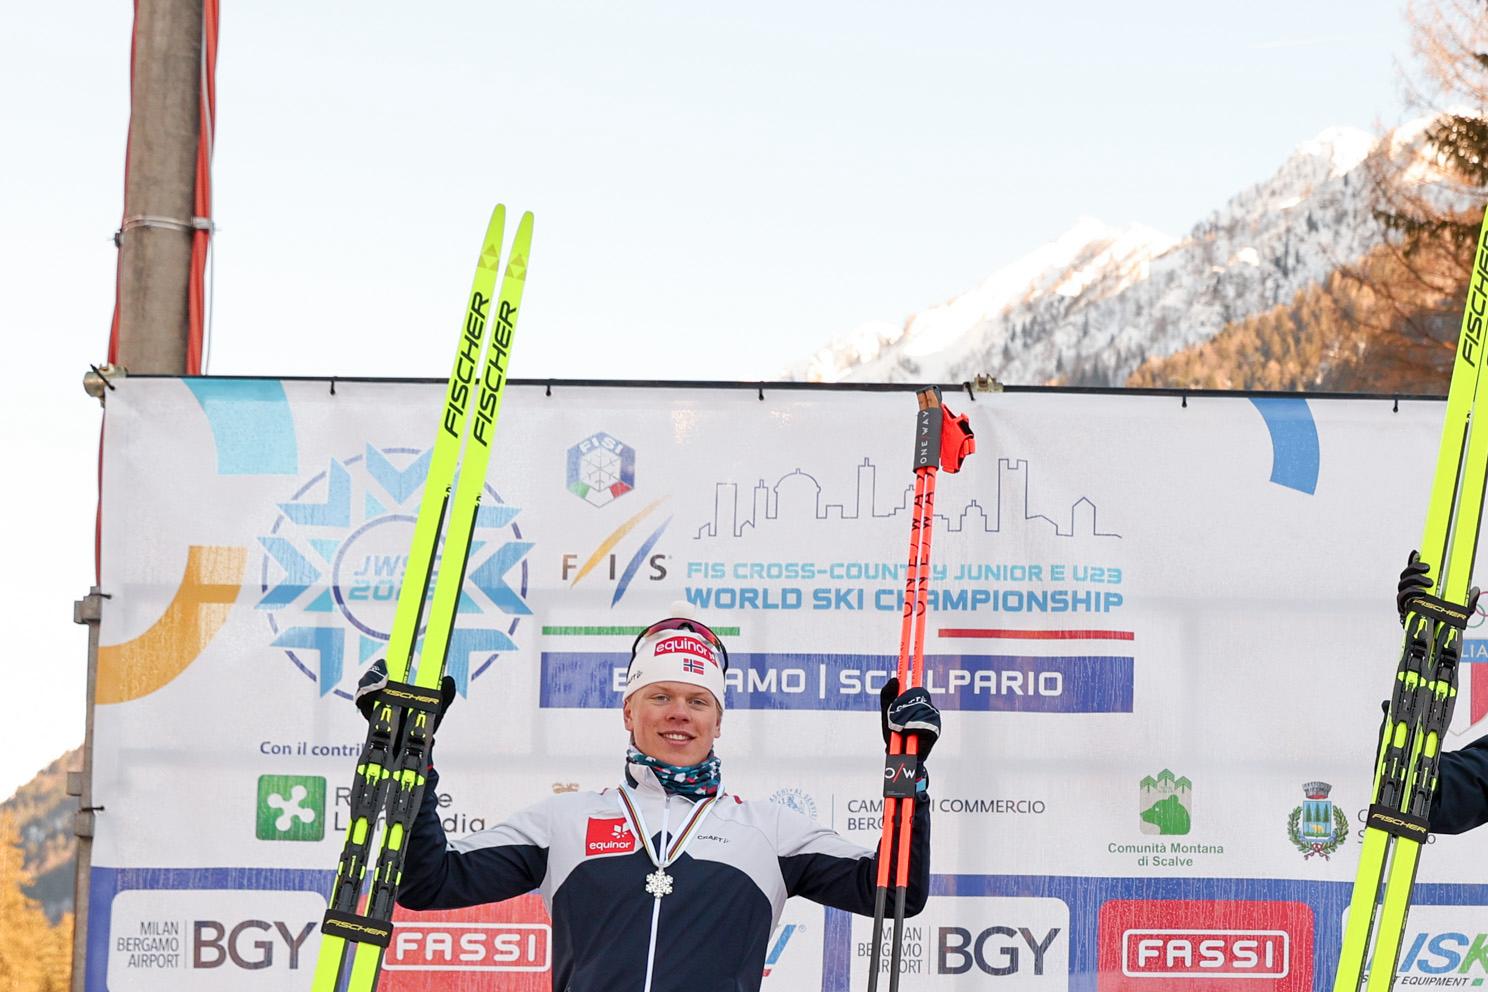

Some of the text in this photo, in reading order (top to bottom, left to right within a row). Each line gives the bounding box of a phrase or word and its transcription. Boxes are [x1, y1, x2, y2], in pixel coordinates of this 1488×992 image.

[444, 291, 489, 438] FISCHER
[473, 300, 517, 447] FISCHER
[687, 561, 1122, 584] FIS CROSS-COUNY JUNIOR E U23
[685, 587, 802, 611] WORLD
[812, 587, 864, 611] SKI
[260, 741, 301, 757] Con il
[940, 800, 1046, 814] COMMERCIO
[589, 840, 631, 853] equinor
[1108, 841, 1224, 855] Comunità Montana
[1137, 856, 1193, 867] di Scalve
[937, 927, 1061, 976] BGY
